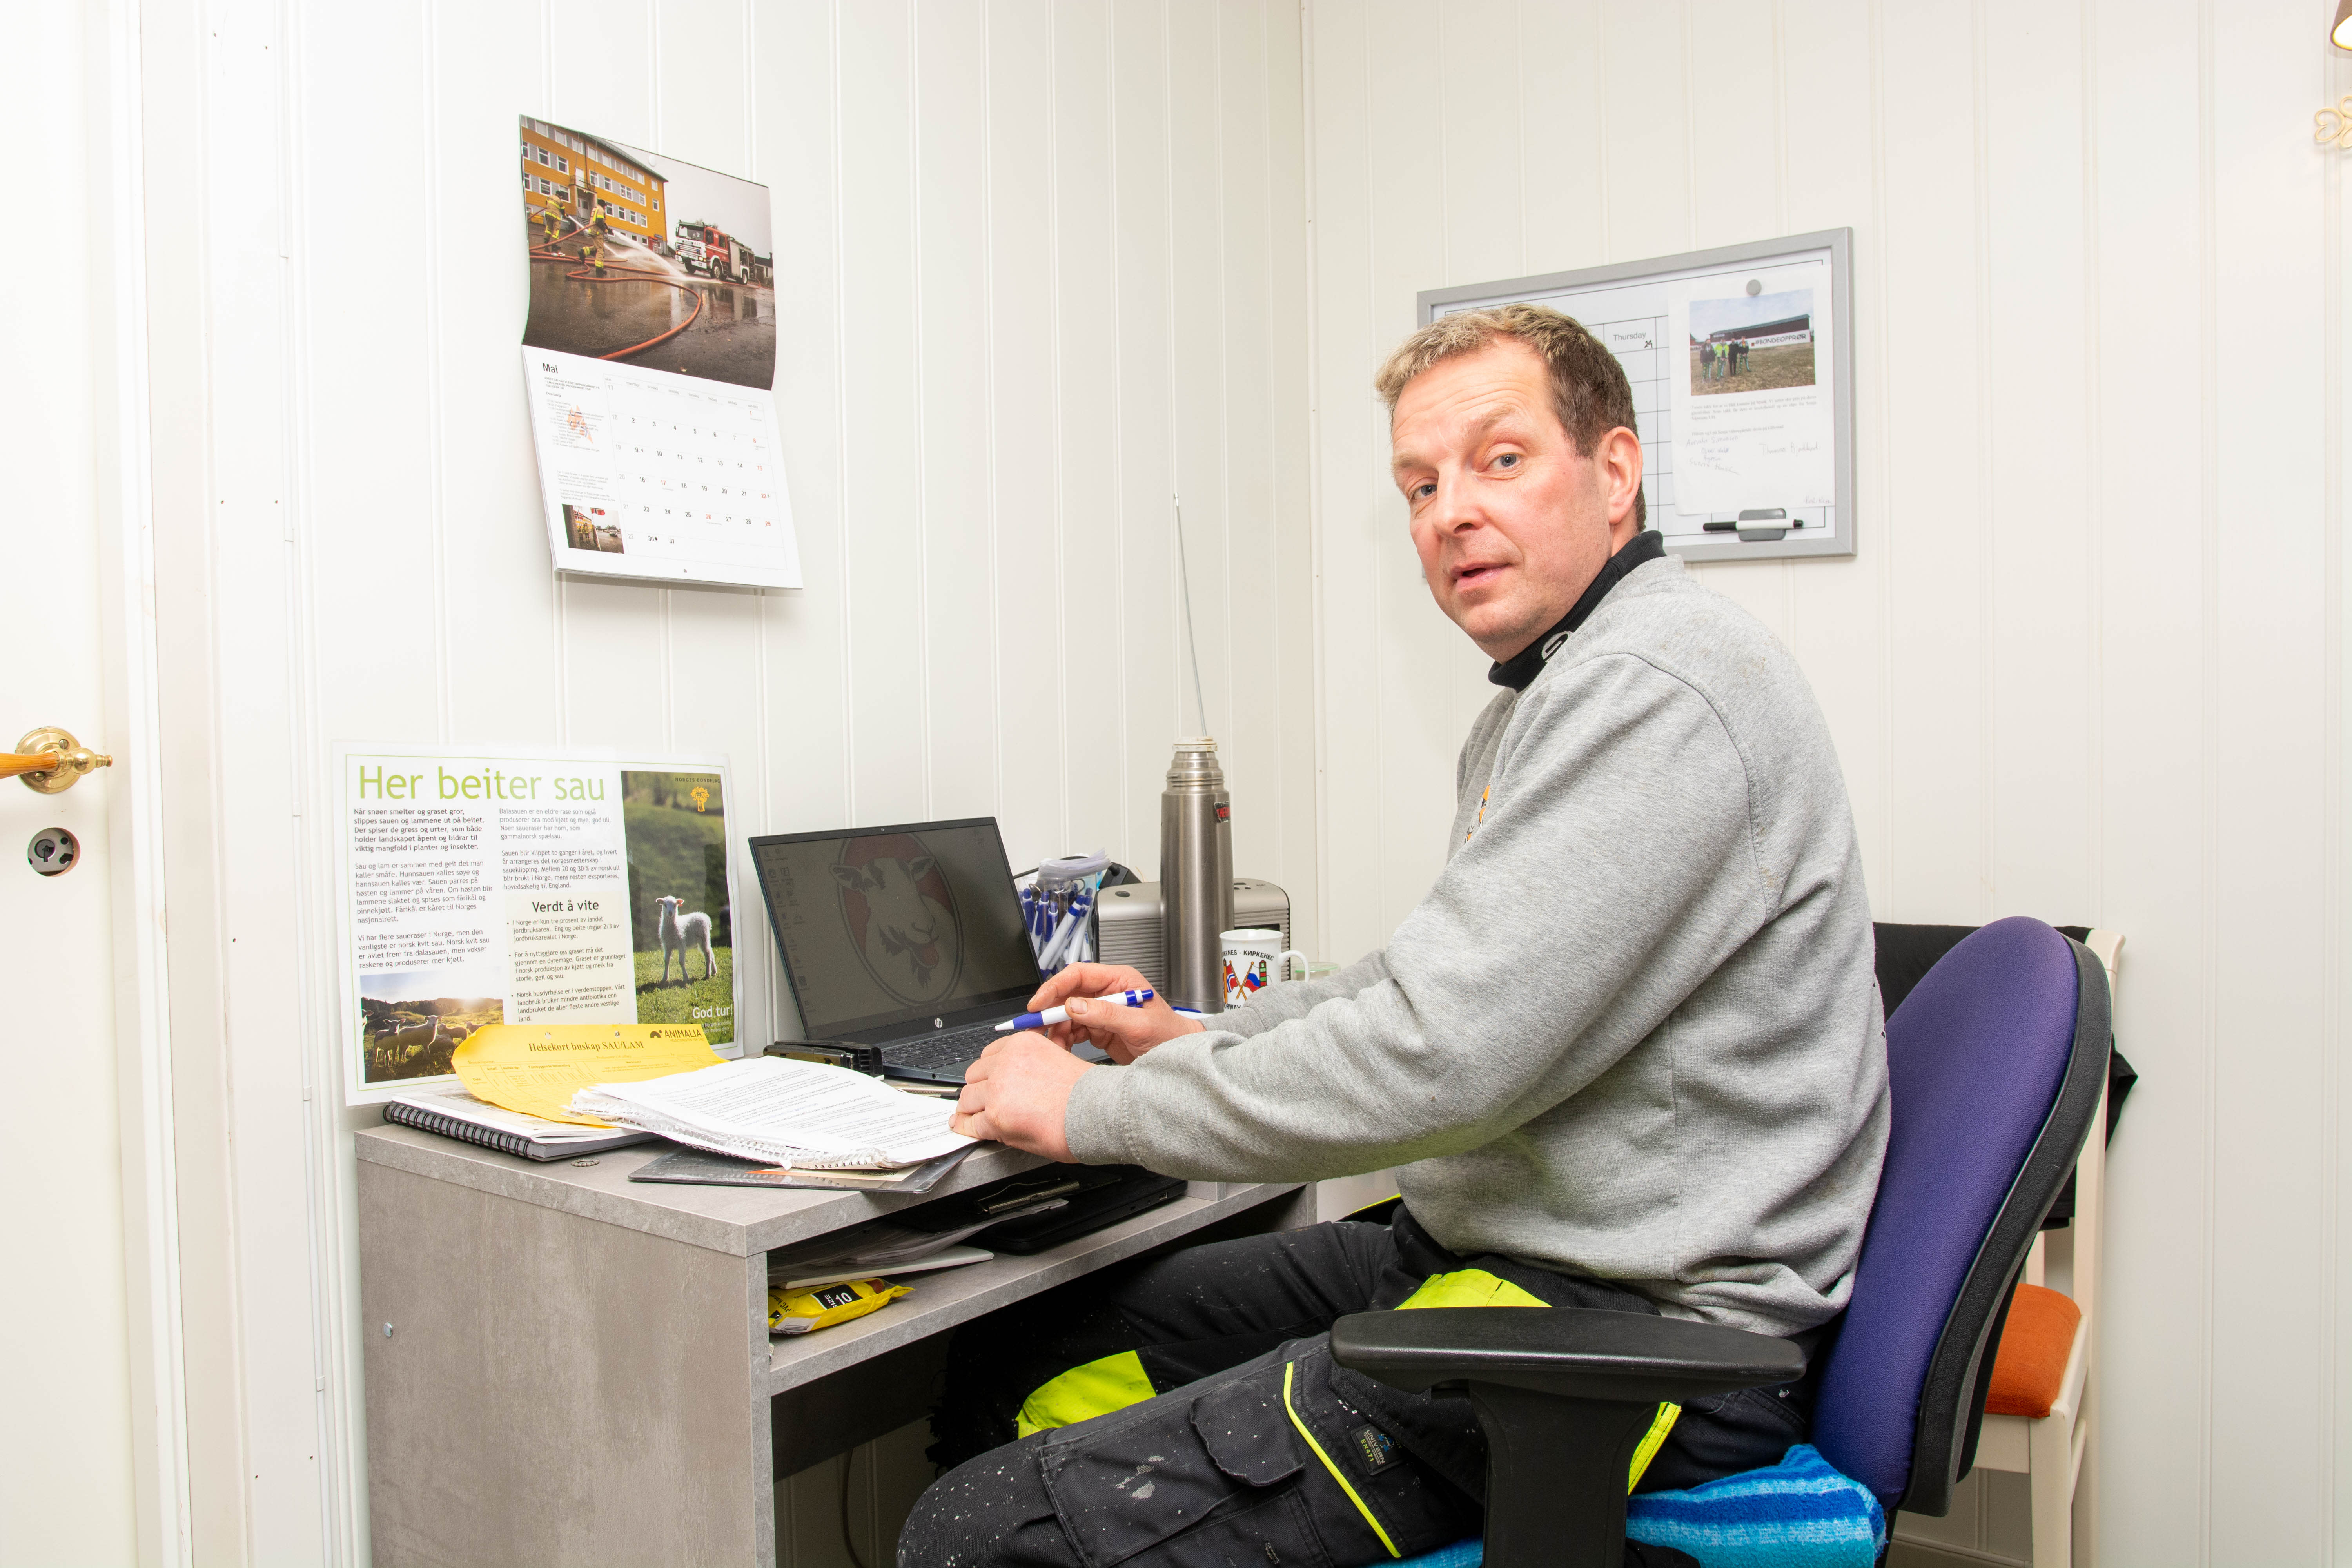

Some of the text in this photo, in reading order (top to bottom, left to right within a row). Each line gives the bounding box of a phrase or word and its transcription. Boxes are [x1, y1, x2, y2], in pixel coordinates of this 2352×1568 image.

[1613, 332, 1646, 341] Thursday
[543, 363, 558, 374] Mai
[360, 766, 604, 800] Her beiter sau
[376, 844, 407, 853] mangfold
[532, 899, 599, 913] Verdt å vite
[395, 959, 430, 967] produserer
[693, 1004, 733, 1019] God tur!
[936, 1018, 942, 1028] hp
[665, 1029, 702, 1038] ANIMALIA
[528, 1041, 644, 1052] Helsekort buskap SAU/LAM
[835, 1292, 852, 1305] 10
[1361, 1439, 1375, 1462] EN471
[1366, 1430, 1386, 1465] UNIVERN
